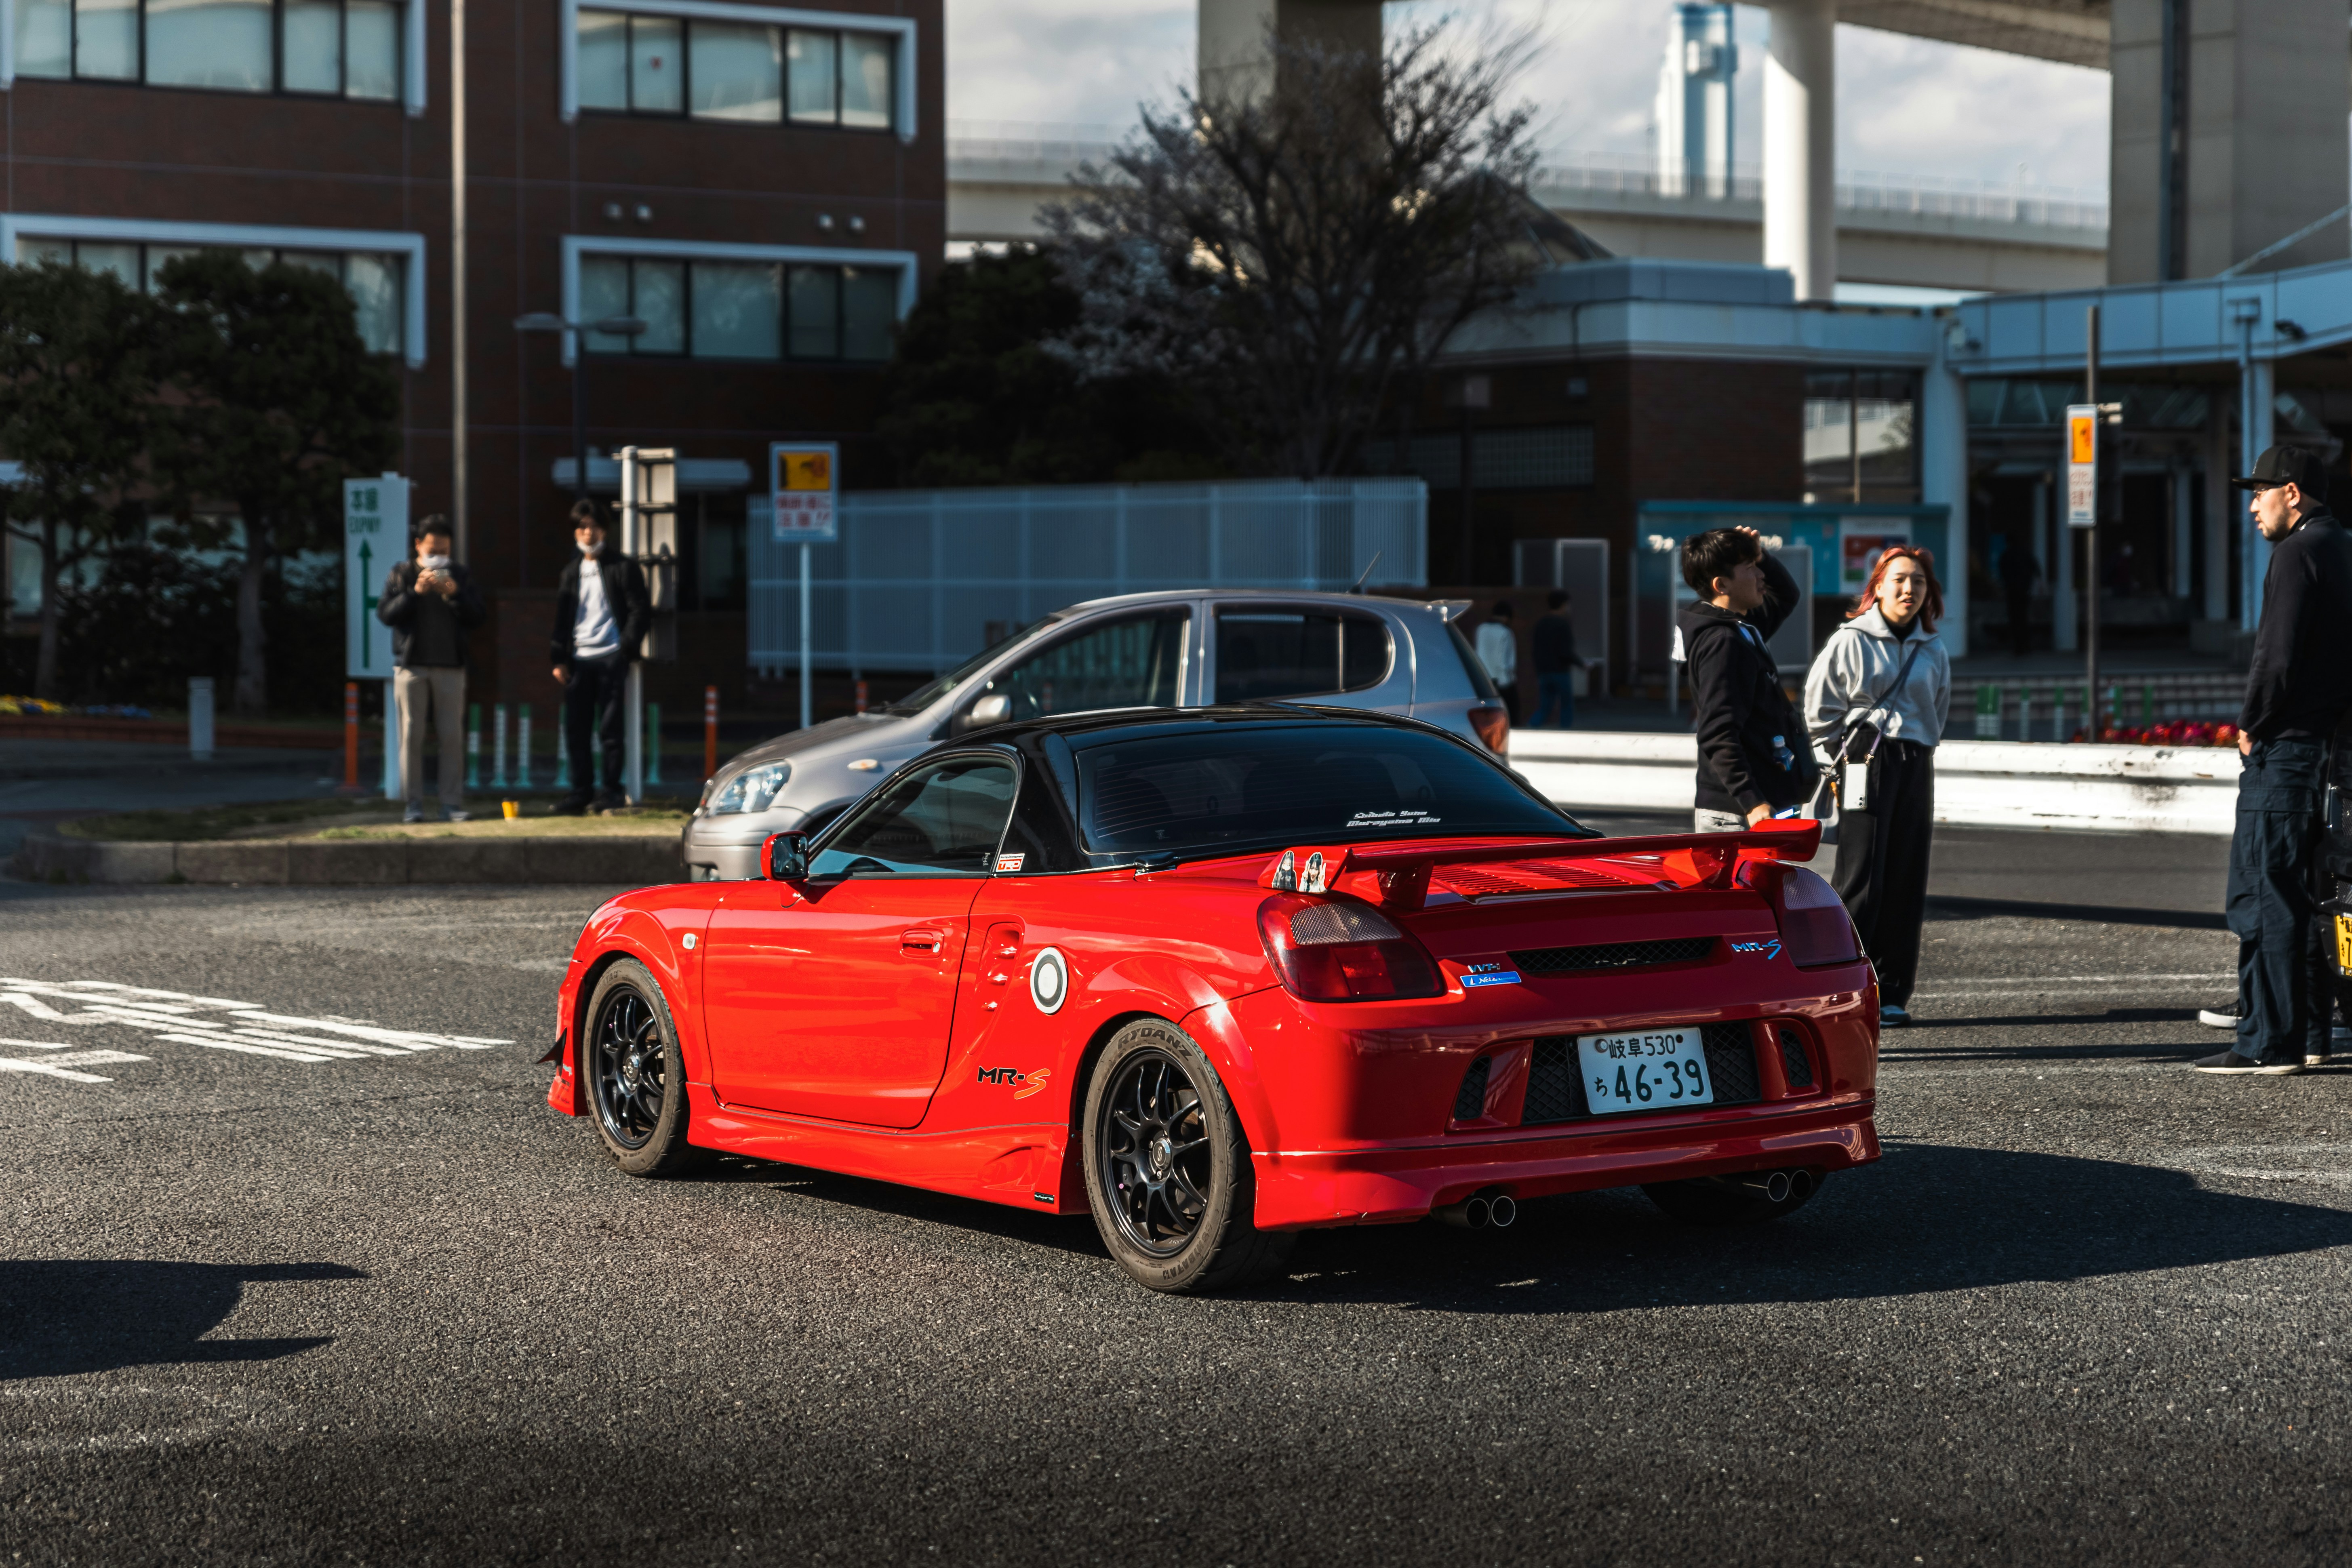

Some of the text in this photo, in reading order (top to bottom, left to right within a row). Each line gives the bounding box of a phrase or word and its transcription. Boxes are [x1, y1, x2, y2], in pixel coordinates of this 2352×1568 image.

[1731, 939, 1781, 960] MR-S
[1118, 1027, 1193, 1062] RYDANZ
[977, 1065, 1051, 1100] MR-S
[1594, 1059, 1704, 1103] ち 46-39
